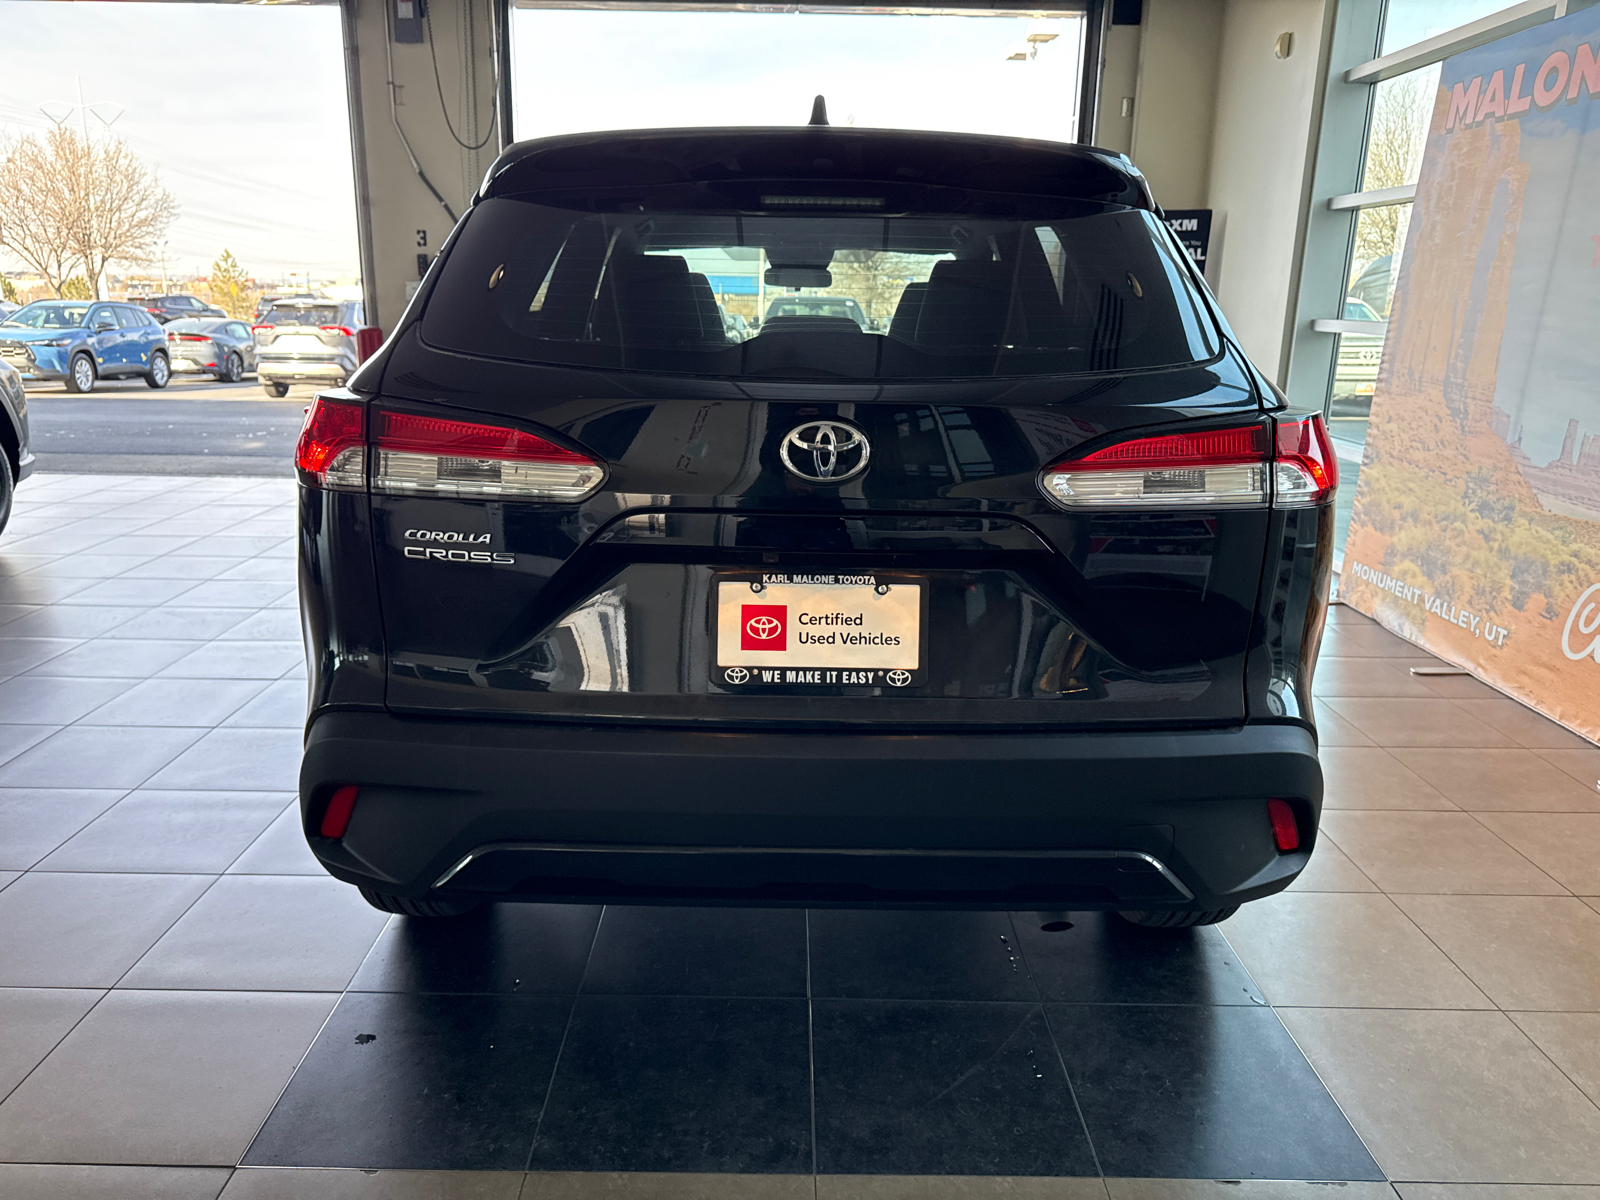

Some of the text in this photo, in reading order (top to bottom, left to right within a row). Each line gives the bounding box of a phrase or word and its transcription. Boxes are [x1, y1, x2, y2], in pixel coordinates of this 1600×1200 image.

[416, 229, 427, 247] 3
[404, 529, 492, 544] COROLLA
[404, 546, 515, 564] CROSS
[762, 574, 876, 585] KARL MALONE TOYOTA
[1352, 560, 1422, 605] MONUMENT
[1424, 593, 1480, 638] VALLEY,
[1484, 621, 1508, 646] UT
[798, 612, 863, 626] Certified
[798, 631, 901, 646] Used Vehicles
[762, 670, 874, 684] WE MAKE IT EASY
